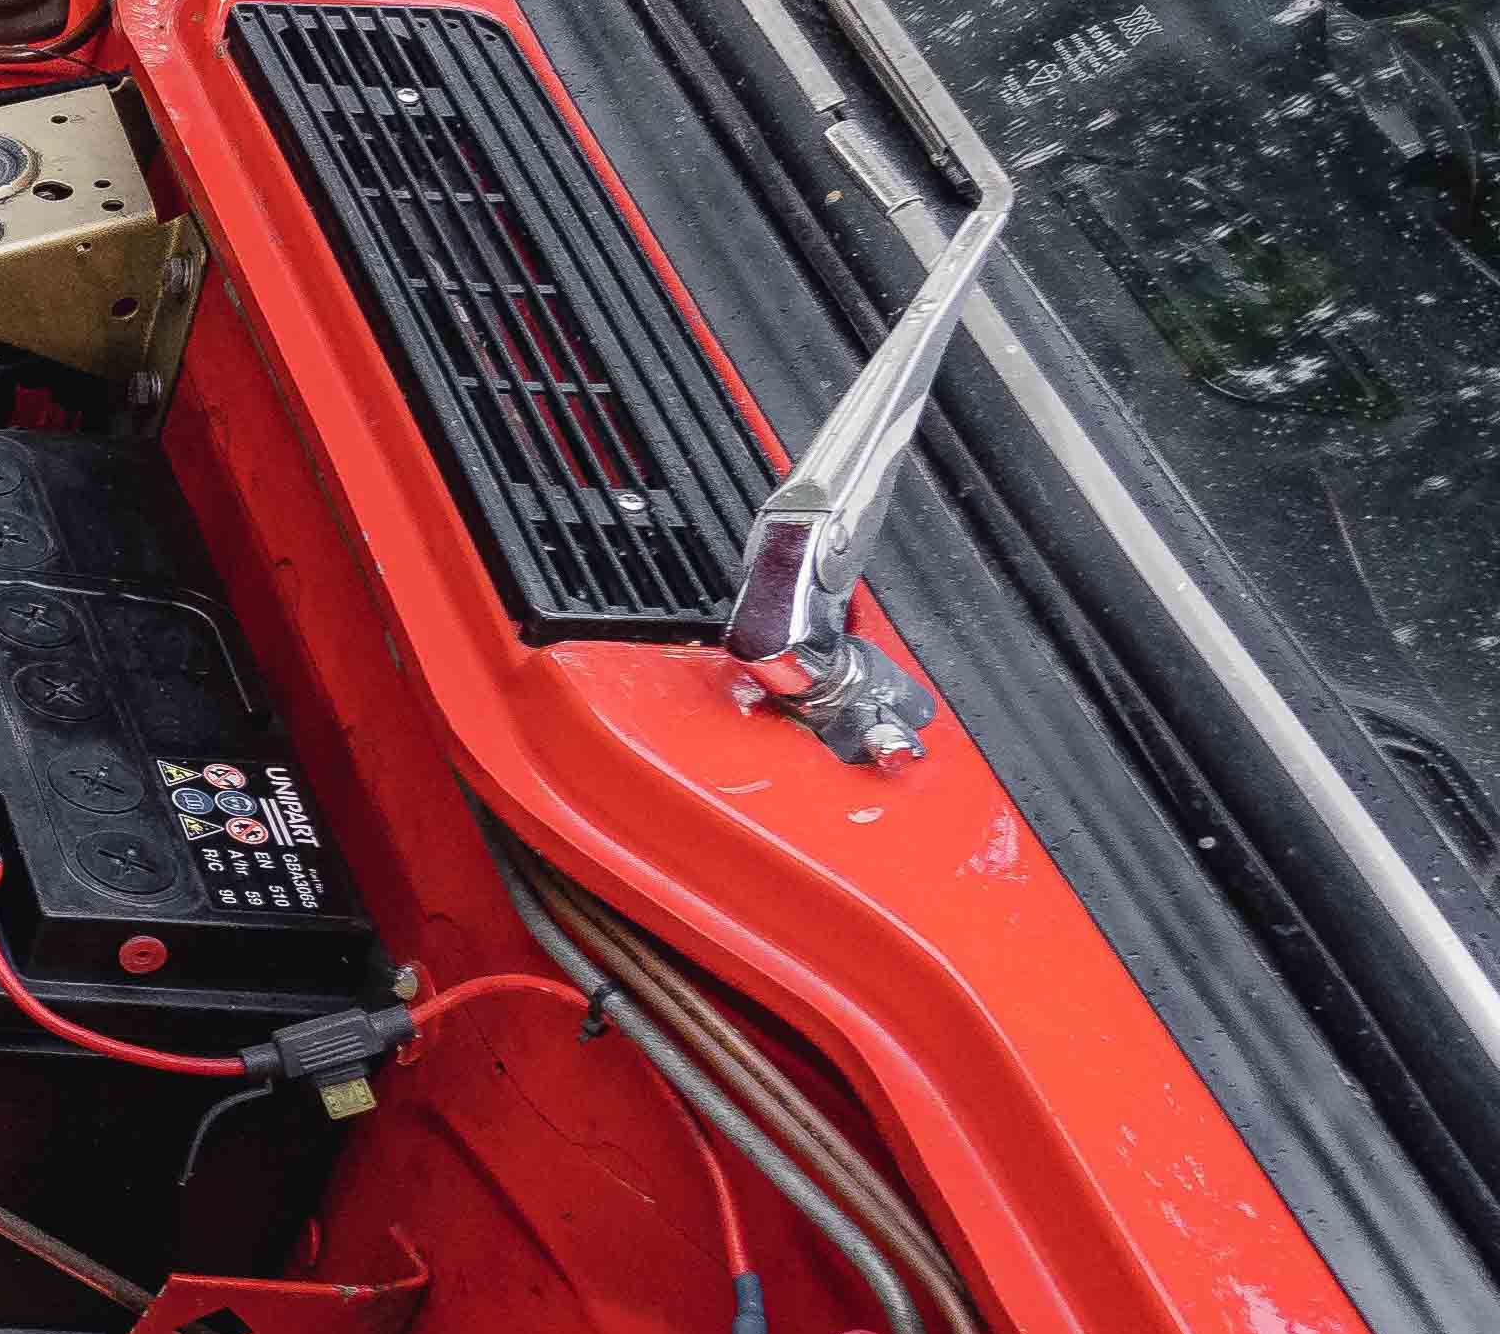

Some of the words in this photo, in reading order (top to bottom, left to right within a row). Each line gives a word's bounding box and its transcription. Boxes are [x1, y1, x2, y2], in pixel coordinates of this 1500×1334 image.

[265, 767, 322, 848] UNIPART
[201, 848, 225, 873] R/C
[254, 851, 277, 869] EN
[268, 884, 291, 907] 510
[282, 853, 320, 909] GBA3065
